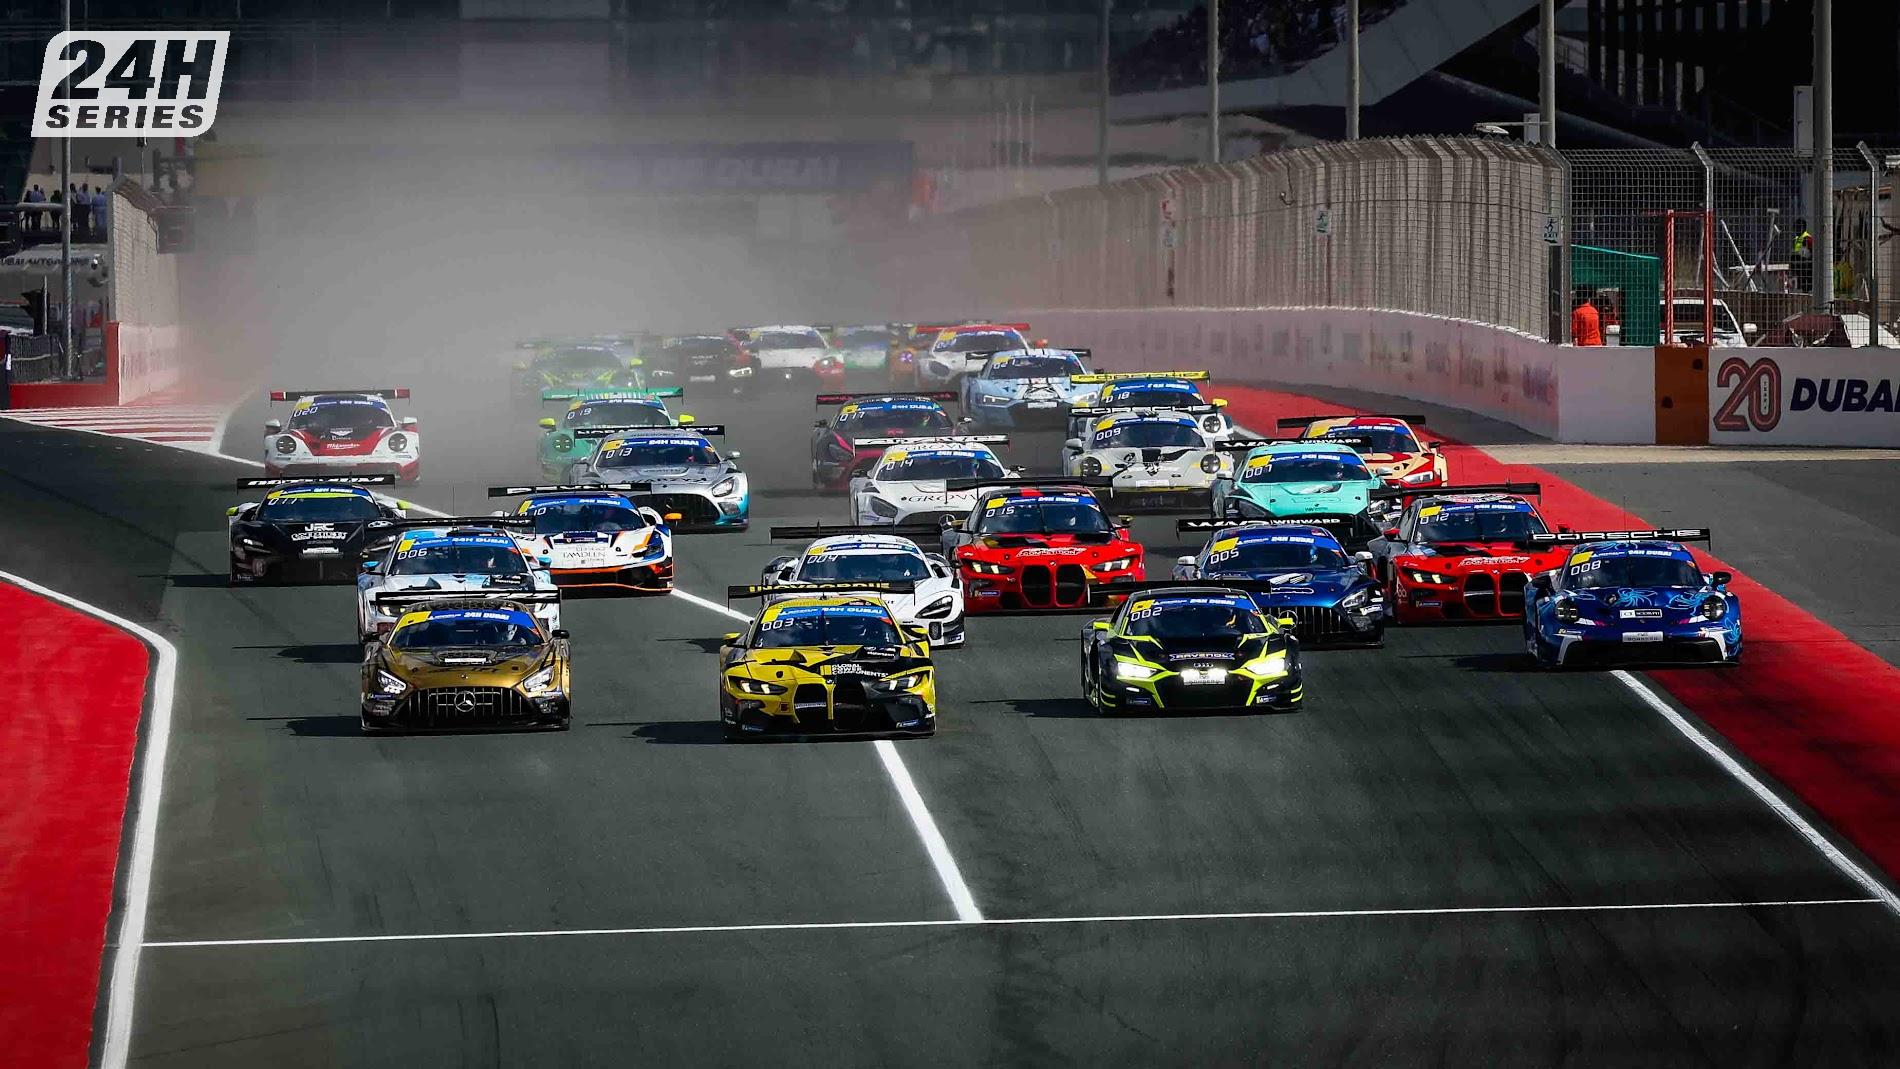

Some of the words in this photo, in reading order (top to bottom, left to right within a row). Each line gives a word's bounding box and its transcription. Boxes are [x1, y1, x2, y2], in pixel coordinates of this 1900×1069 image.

[1713, 357, 1781, 432] 20
[1096, 428, 1121, 440] 009
[304, 522, 334, 531] JRC
[1532, 529, 1701, 541] PORSCHE
[398, 548, 427, 560] 006
[1210, 548, 1240, 564] 005
[1570, 560, 1601, 575] 008
[1131, 607, 1162, 621] 002
[761, 618, 794, 631] 003
